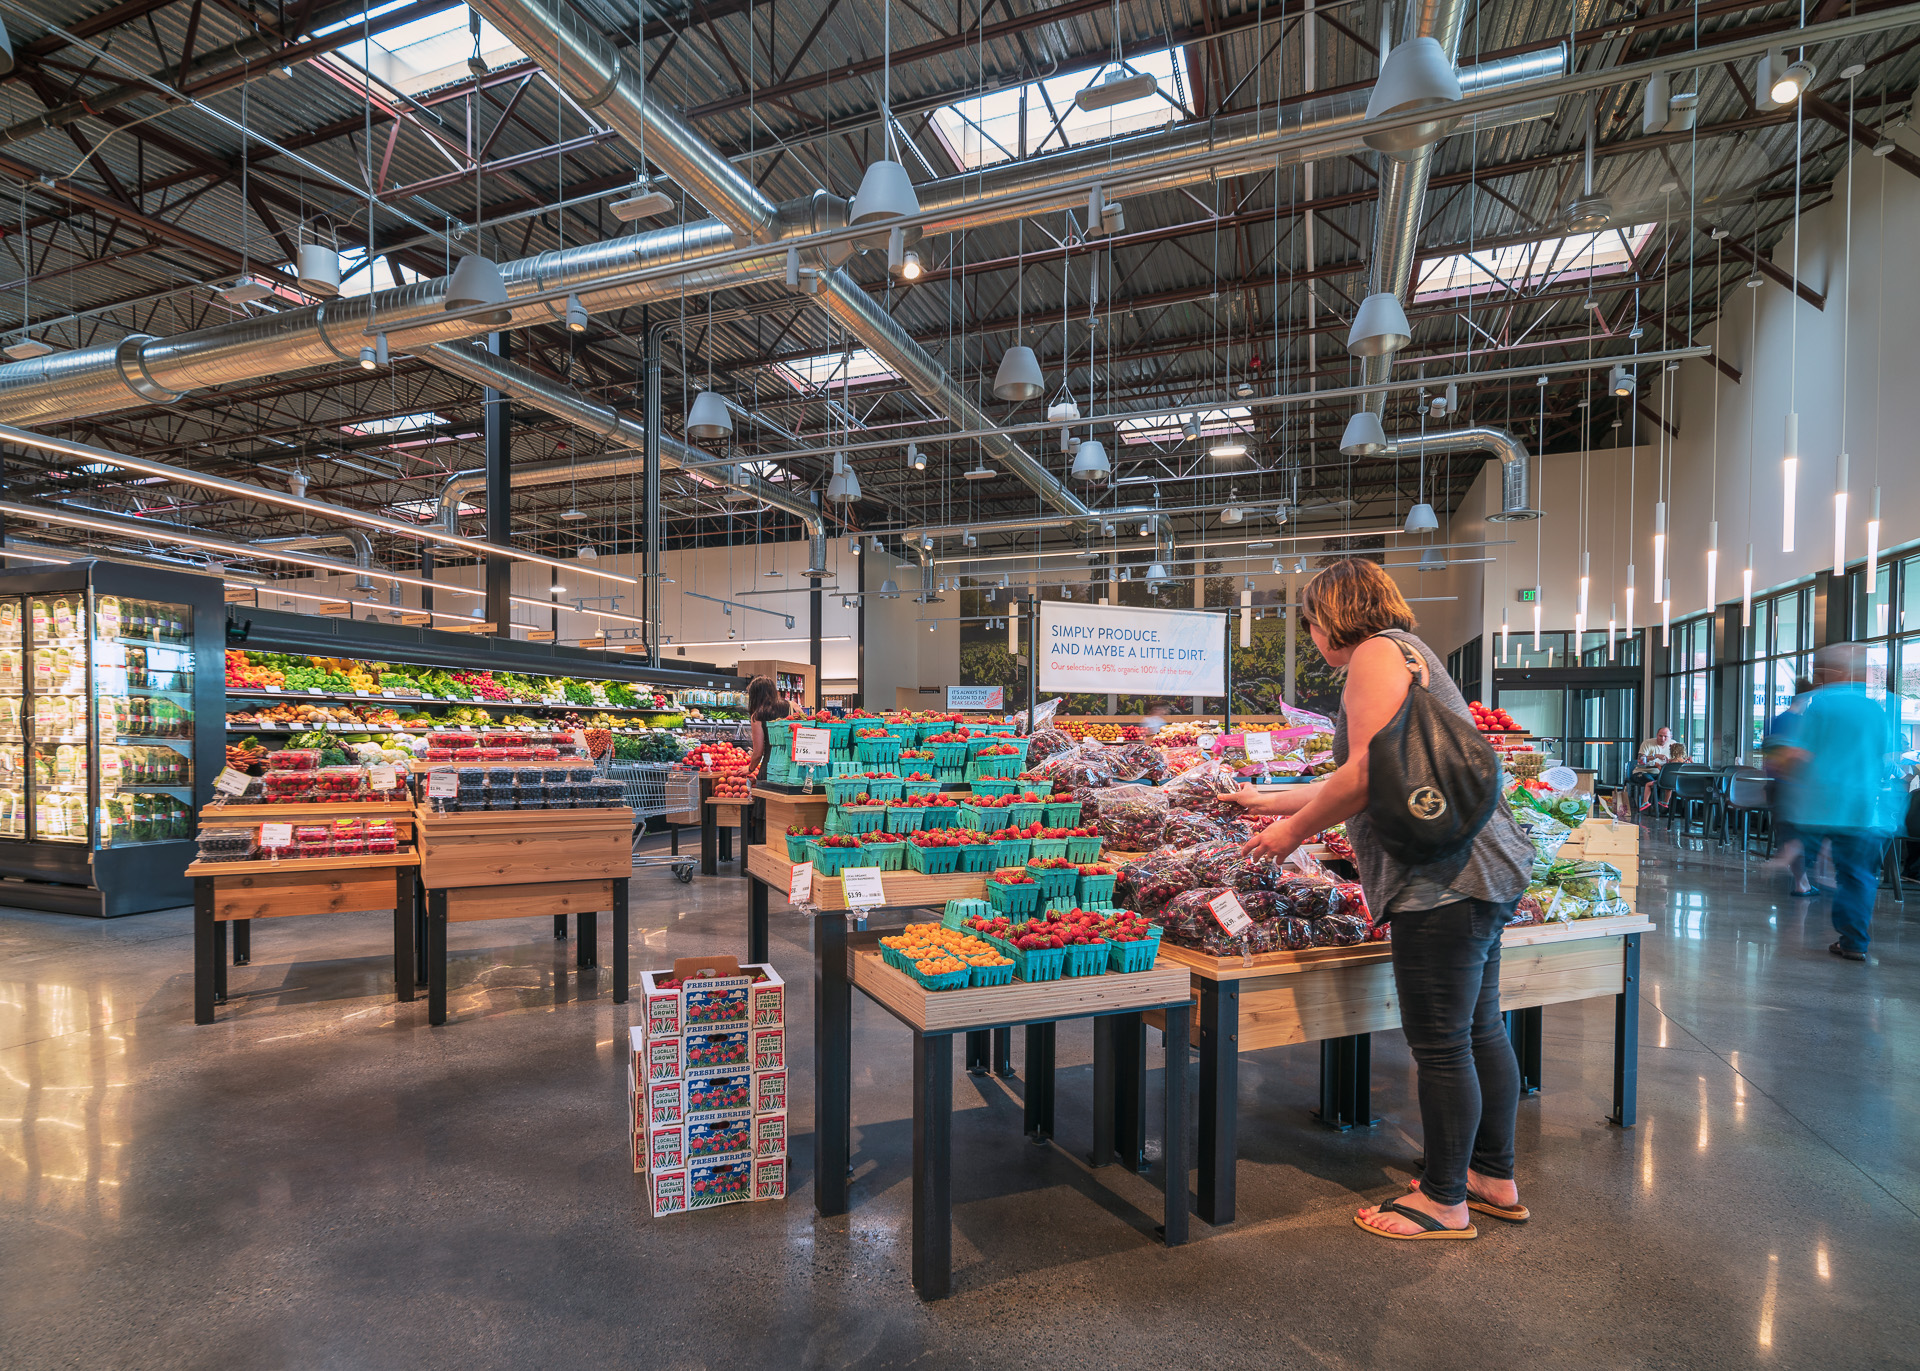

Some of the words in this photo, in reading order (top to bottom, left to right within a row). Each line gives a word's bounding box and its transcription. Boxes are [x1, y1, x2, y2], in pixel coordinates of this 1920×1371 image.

[1524, 590, 1536, 600] EXIT
[1052, 624, 1094, 638] SIMPLY
[1098, 628, 1160, 642] PRODUCE.
[1051, 642, 1080, 655] AND
[1084, 644, 1125, 657] MAYBE
[1128, 647, 1136, 658] A
[1140, 647, 1174, 659] LITTLE
[1178, 649, 1206, 661] DIRT.
[1051, 661, 1065, 670] Our
[1066, 663, 1094, 672] selection
[1102, 664, 1116, 673] 95%
[1118, 666, 1139, 675] organic
[1141, 666, 1158, 674] 100%
[715, 1022, 748, 1030] BERRIES
[717, 1066, 750, 1074] BERRIES
[717, 1110, 750, 1118] BERRIES
[692, 1157, 718, 1165] FRESH
